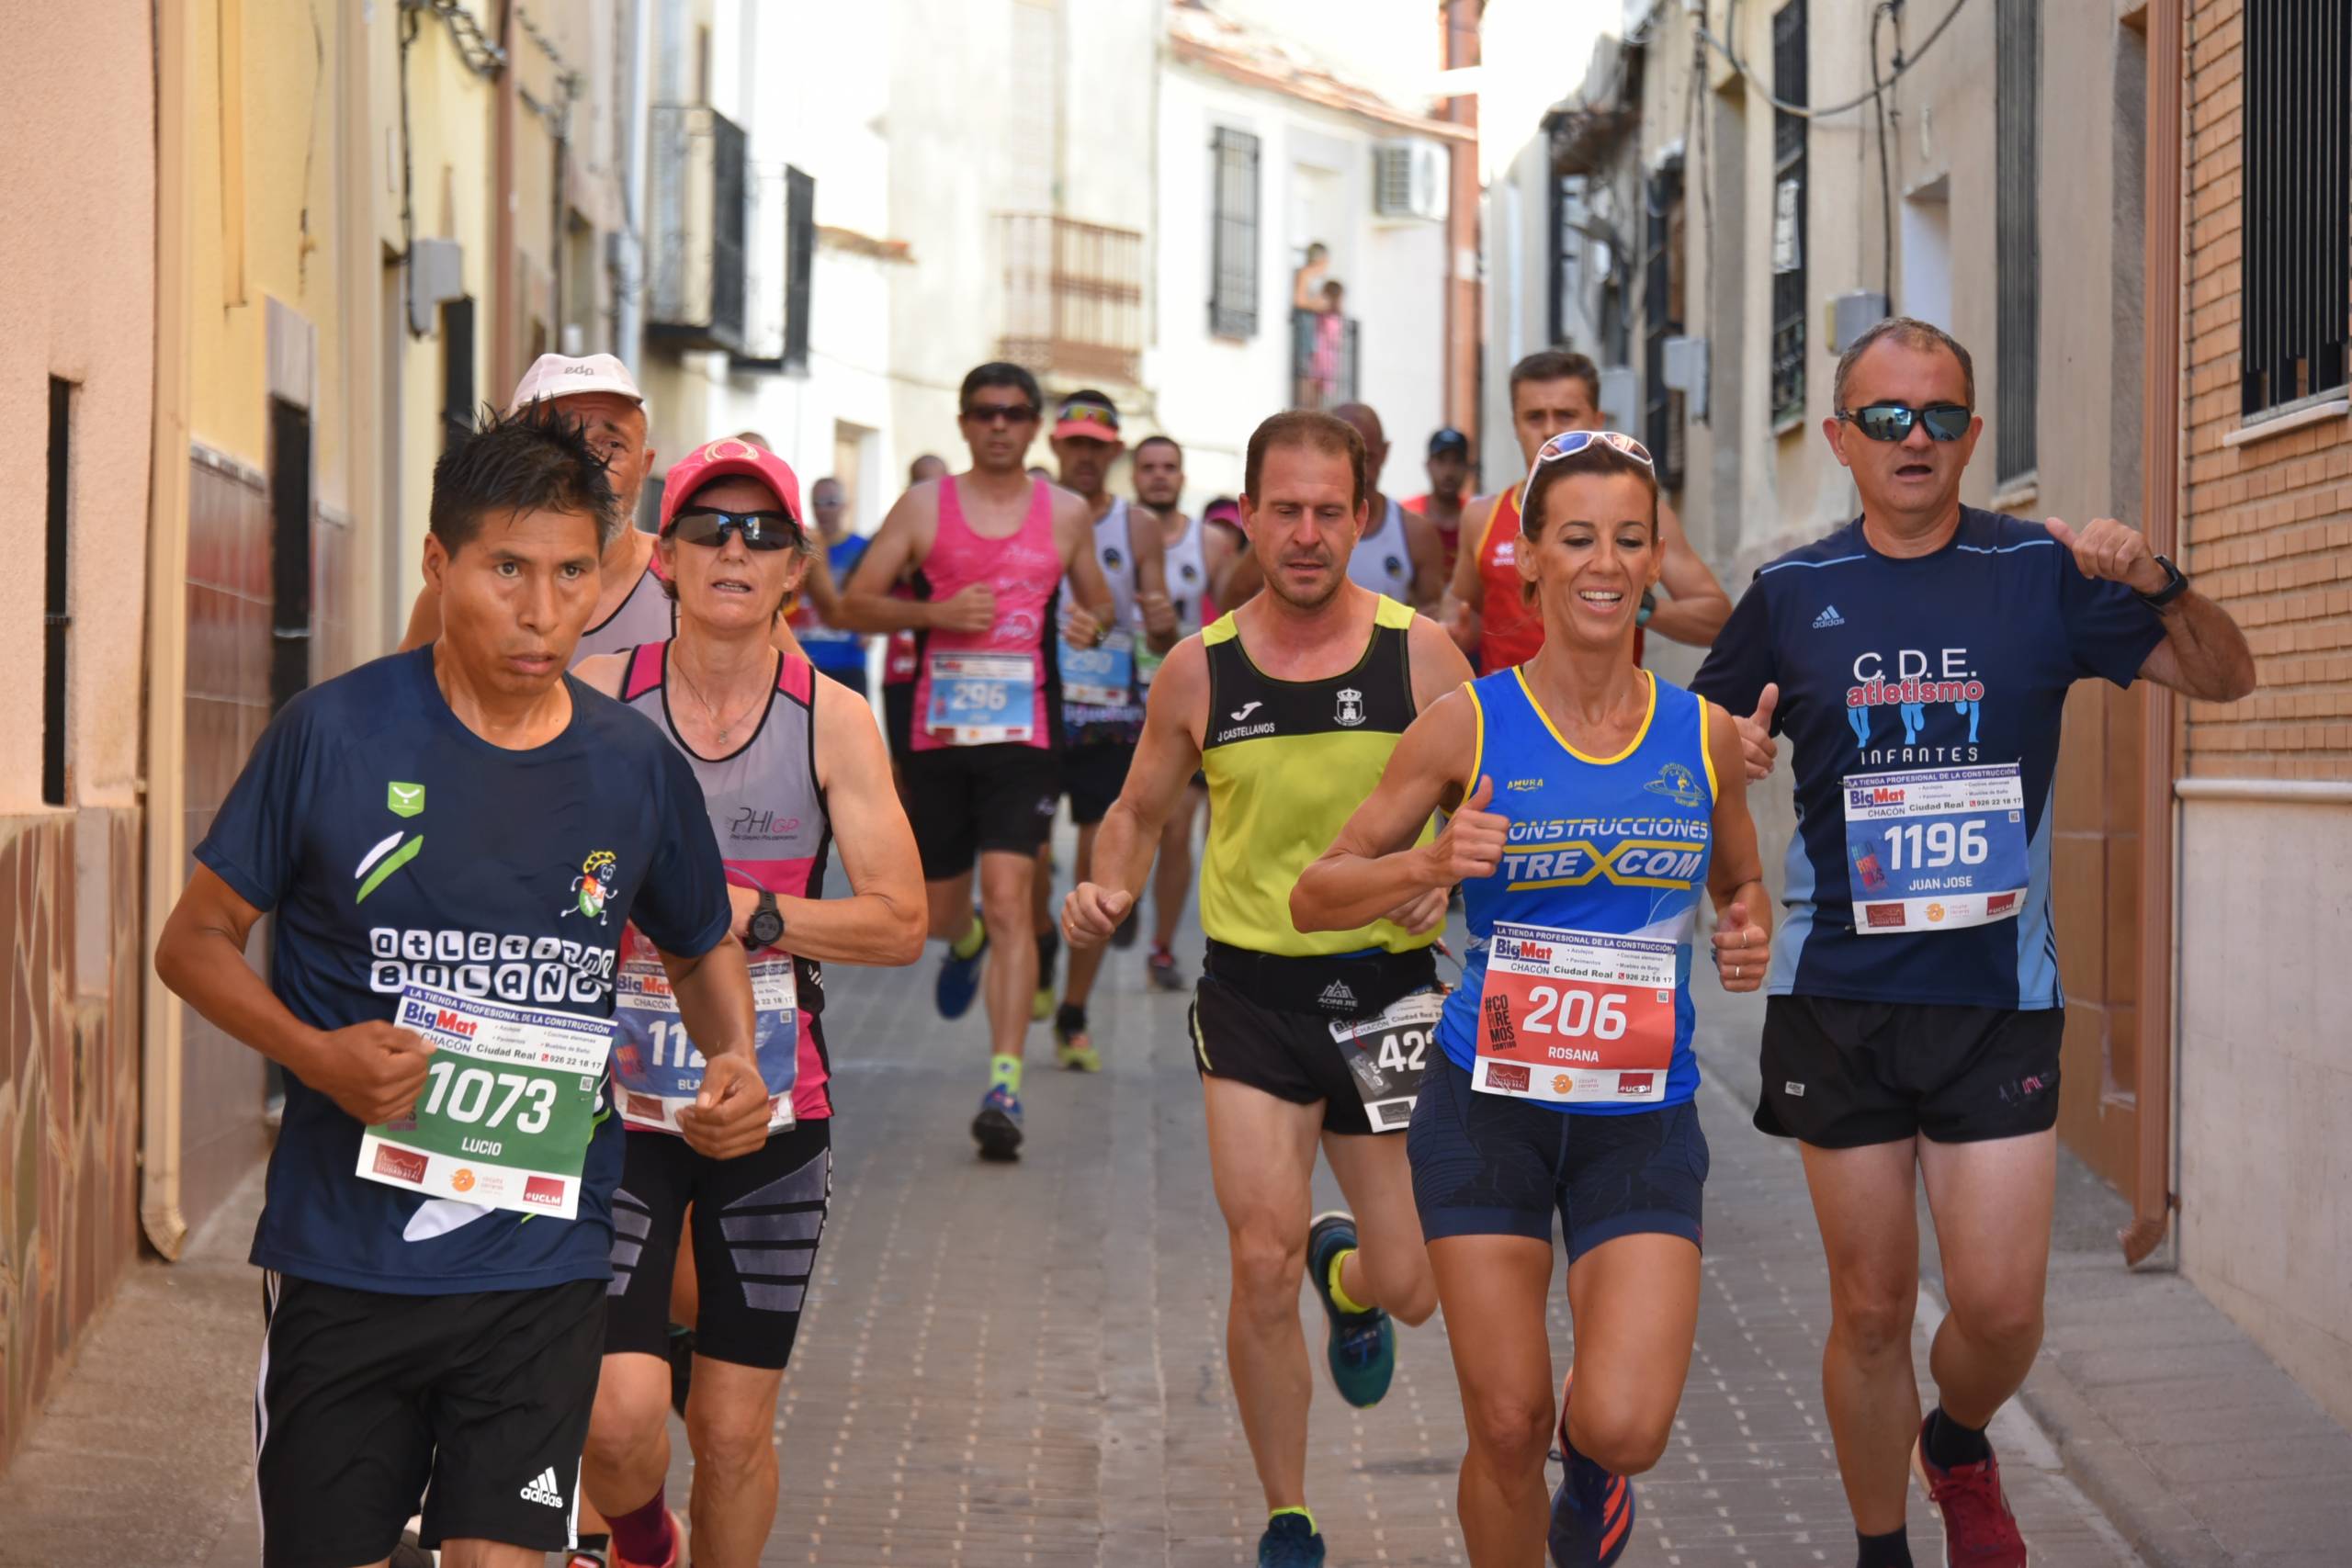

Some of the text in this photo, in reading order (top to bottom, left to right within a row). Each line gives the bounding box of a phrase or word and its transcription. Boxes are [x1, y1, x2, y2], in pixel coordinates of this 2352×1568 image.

[1812, 617, 1845, 629] adidas
[951, 682, 1008, 711] 296
[1846, 677, 1984, 707] atletismo
[1223, 722, 1275, 740] CASTELLANOS
[1860, 747, 1978, 765] INFANTES
[1860, 778, 1885, 786] TIENDA
[1886, 773, 1938, 784] PROFESIONAL
[1850, 788, 1905, 807] BigMat
[1909, 802, 1941, 811] Ciudad
[1944, 800, 1964, 809] Real
[2013, 796, 2021, 805] 17
[1868, 807, 1905, 818] CHACÓN
[1508, 818, 1708, 840] ONSTRUCCIONES
[1884, 819, 1988, 870] 1196
[1909, 876, 1973, 891] JUAN JOSE
[1508, 928, 1534, 938] TIENDA
[1535, 931, 1589, 944] PROFESIONAL
[1592, 938, 1602, 946] DE
[1496, 938, 1553, 960] BigMat
[1510, 962, 1550, 975] CHACÓN
[1555, 965, 1589, 976] Ciudad
[1591, 970, 1613, 979] Real
[1641, 974, 1649, 982] 22
[404, 1001, 478, 1036] BigMat
[410, 988, 610, 1034] LA TIENDA PROFESIONAL DE LA CONSTRUCCIÓN
[1391, 1012, 1418, 1022] Ciudad
[1521, 986, 1627, 1040] 206
[1489, 1026, 1515, 1043] MOS
[476, 1043, 512, 1057] Ciudad
[514, 1049, 537, 1061] Real
[550, 1055, 565, 1065] 926
[567, 1057, 577, 1066] 22
[592, 1061, 602, 1069] 17
[1378, 1031, 1433, 1073] 42
[1548, 1046, 1600, 1063] ROSANA
[425, 1061, 558, 1134] 1073
[461, 1137, 502, 1156] LUCIO
[531, 1192, 561, 1204] UCLM
[520, 1487, 563, 1508] adidas
